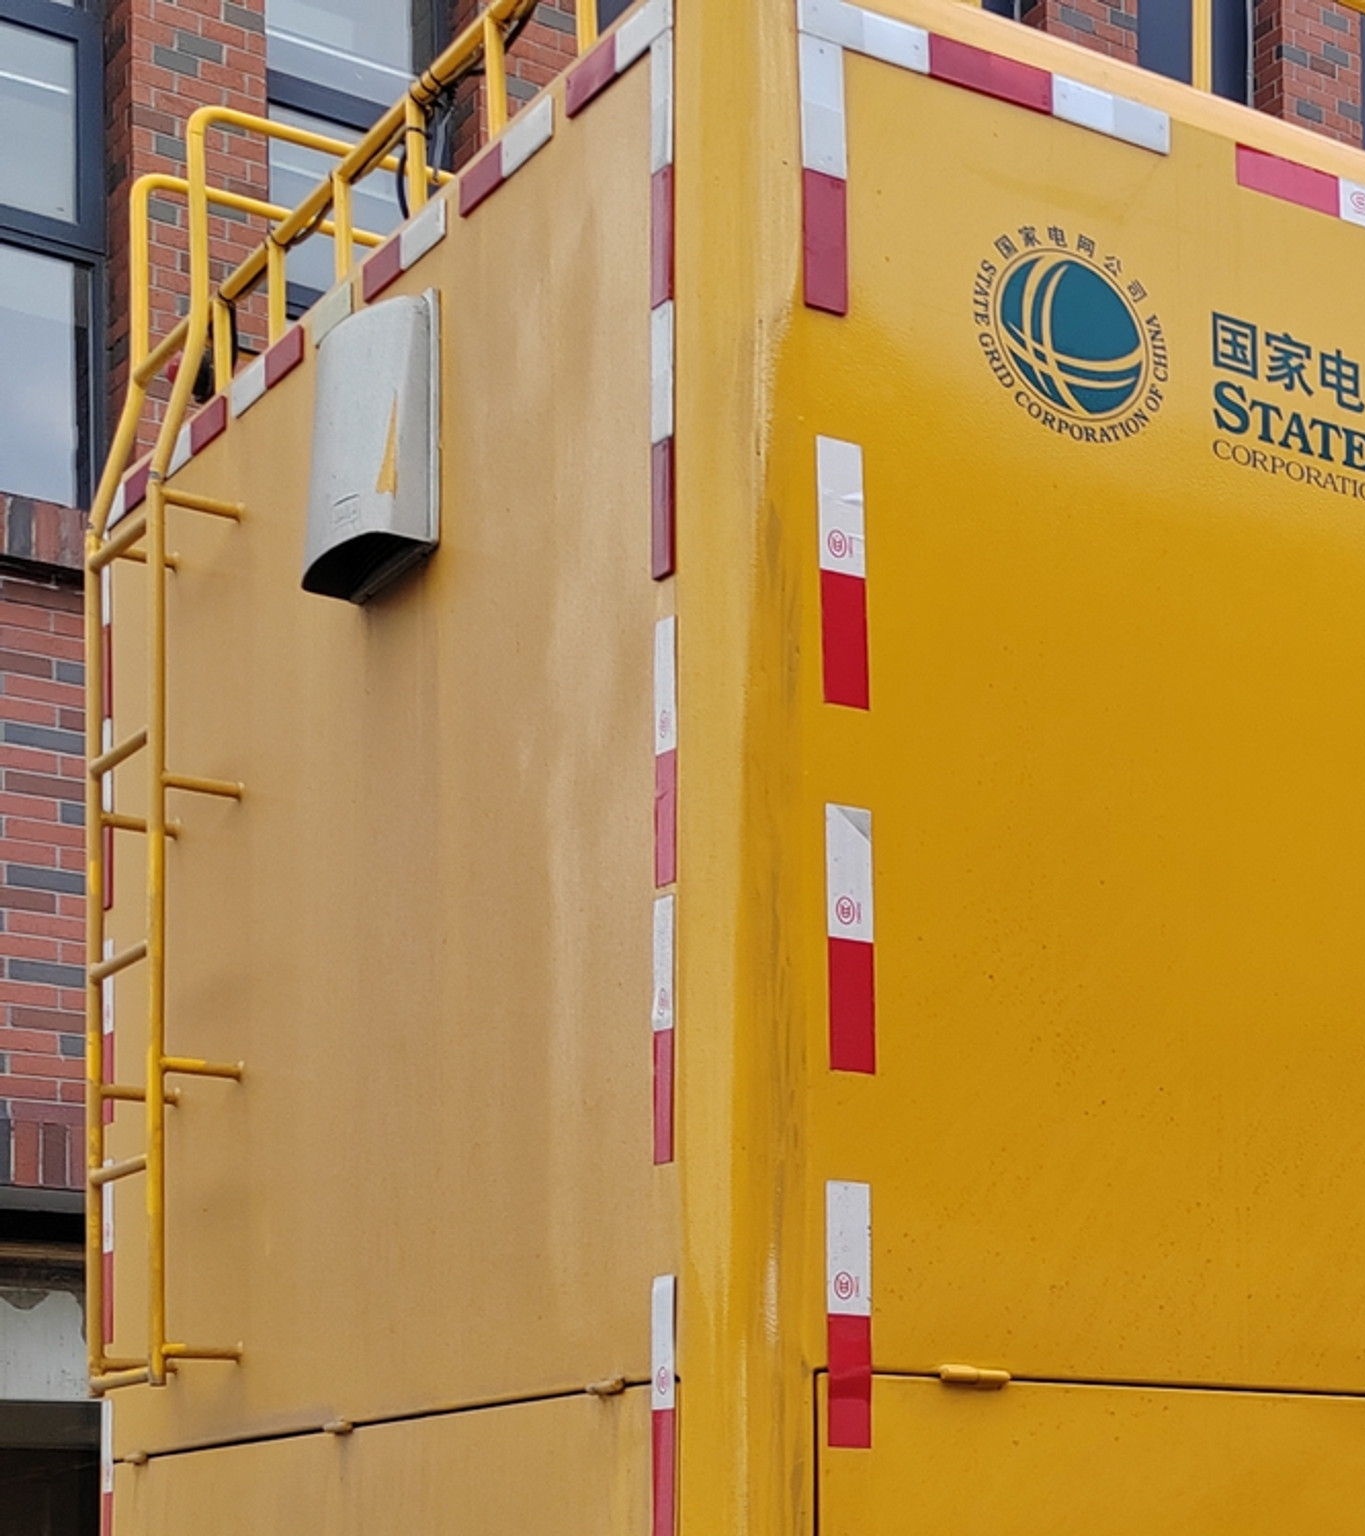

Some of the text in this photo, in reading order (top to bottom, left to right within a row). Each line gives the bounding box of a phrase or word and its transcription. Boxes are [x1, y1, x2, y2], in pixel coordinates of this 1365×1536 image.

[994, 225, 1148, 303] 国家电网公司
[973, 259, 1169, 443] STATE GRID CORPORATION OF CHINA
